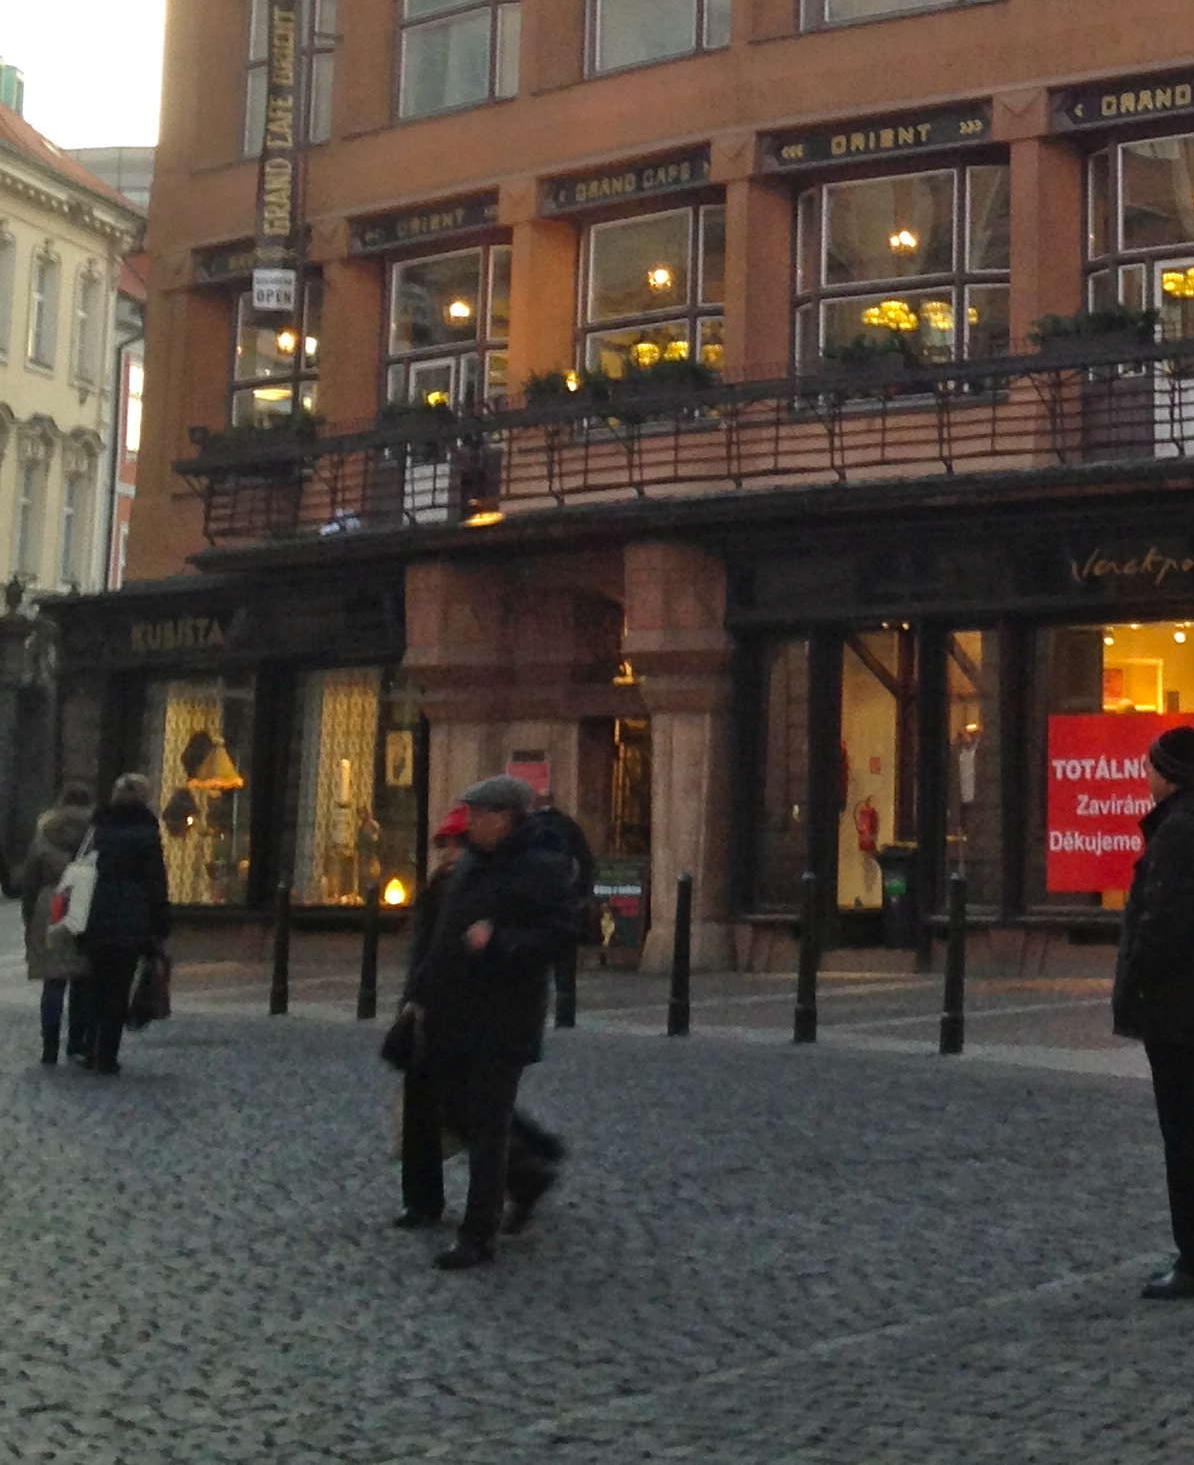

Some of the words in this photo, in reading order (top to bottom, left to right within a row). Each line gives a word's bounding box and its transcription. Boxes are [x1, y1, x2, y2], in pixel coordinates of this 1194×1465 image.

[1101, 83, 1192, 116] GRAND
[266, 94, 294, 149] CAFE
[831, 123, 931, 155] ORIENT
[263, 157, 292, 235] GRAND
[575, 173, 637, 202] GRAND
[642, 161, 691, 188] CAFE
[256, 289, 292, 304] OPEN
[1076, 793, 1153, 815] Zavírám
[1049, 830, 1142, 855] Děkujeme
